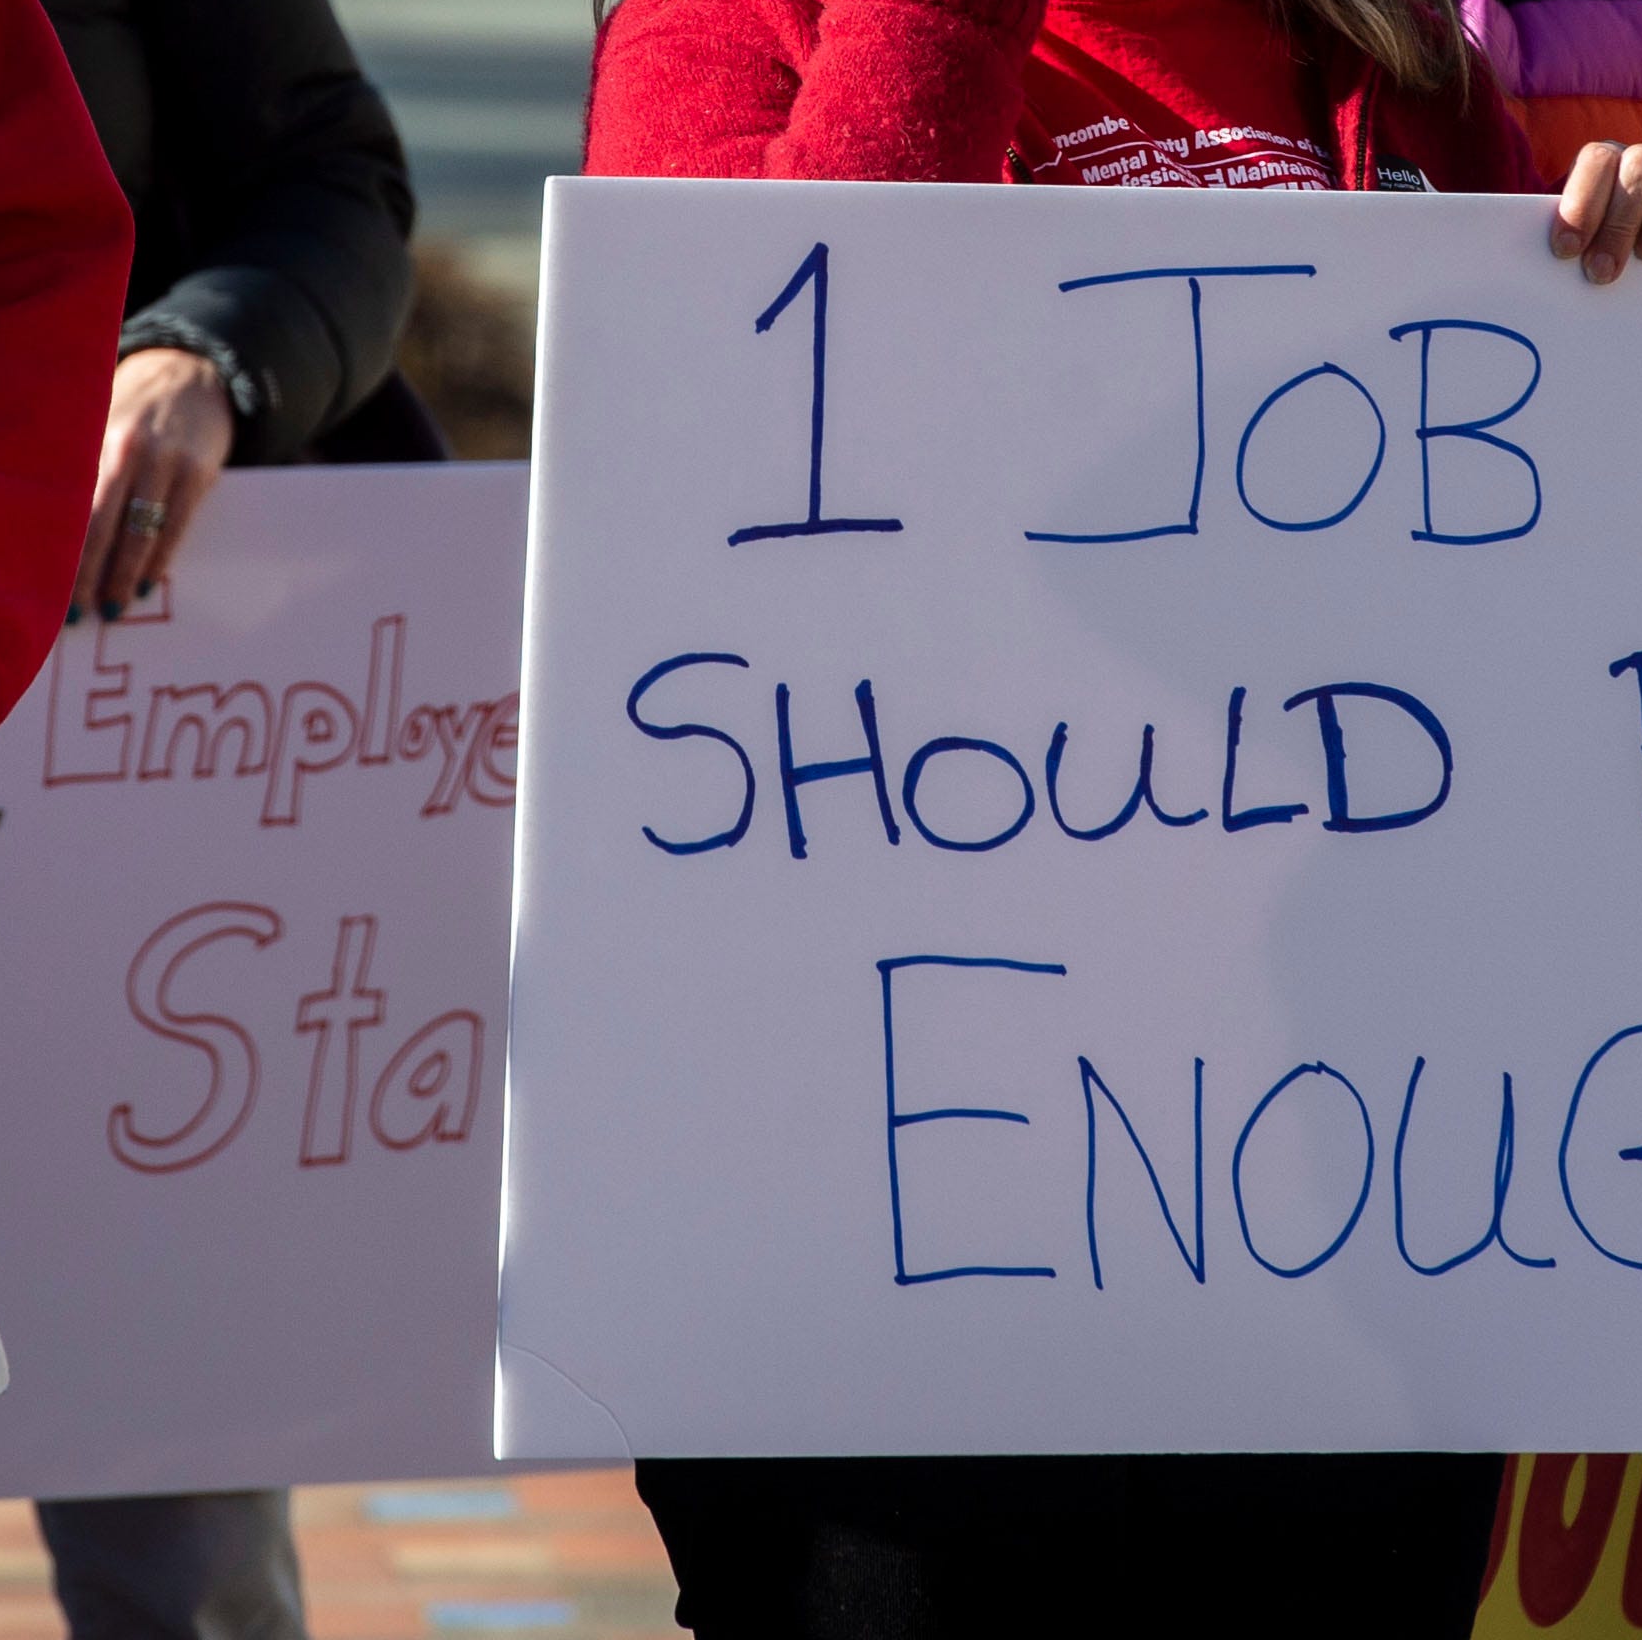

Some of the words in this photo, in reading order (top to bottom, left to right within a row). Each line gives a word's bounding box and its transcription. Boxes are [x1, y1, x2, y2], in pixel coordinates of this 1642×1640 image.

[1052, 116, 1130, 148] ncombe
[1195, 126, 1294, 150] Association
[1082, 150, 1148, 185] Mental
[1376, 167, 1421, 185] Hello
[728, 241, 904, 546] 1
[106, 899, 487, 1176] Sta
